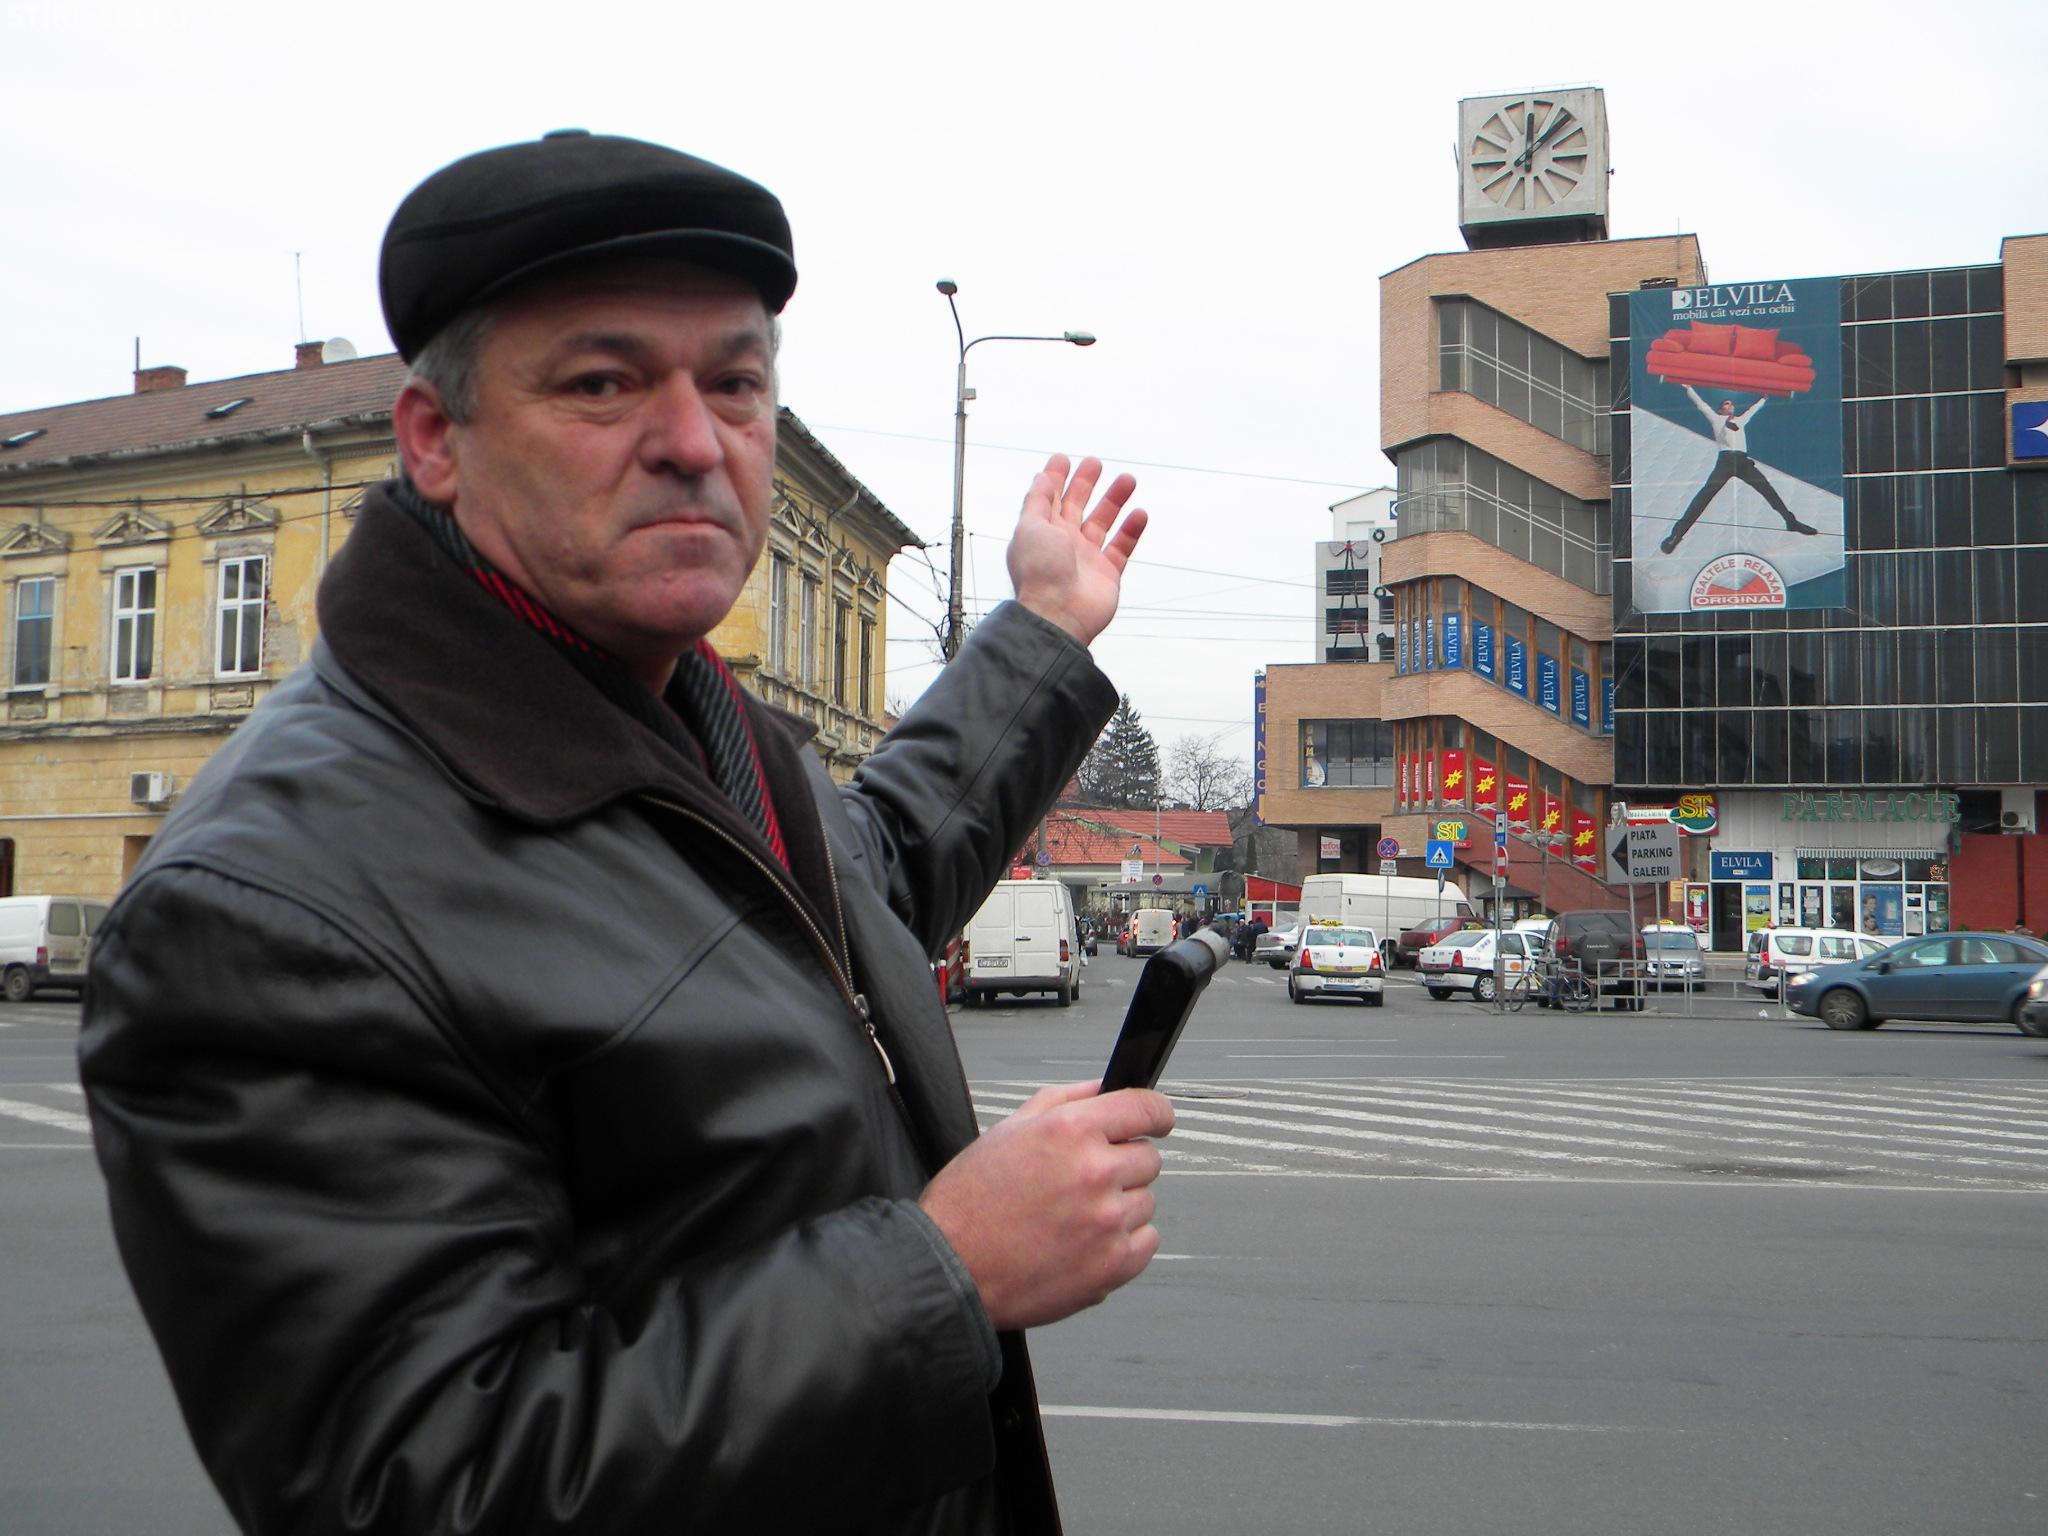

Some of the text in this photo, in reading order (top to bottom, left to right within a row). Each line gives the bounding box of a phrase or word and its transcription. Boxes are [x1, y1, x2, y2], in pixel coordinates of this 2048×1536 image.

[1729, 305, 1751, 317] vezi
[1753, 307, 1766, 315] cu
[1769, 303, 1795, 314] ochii
[1695, 558, 1735, 596] SALTELE
[1744, 558, 1780, 594] RELAXA
[1695, 595, 1782, 605] ORIGINAL
[1478, 625, 1488, 662] ELVILA
[1511, 641, 1521, 681] ELVILA
[1543, 659, 1554, 701] ELVILA
[1575, 673, 1585, 711] ELVILA
[1680, 795, 1712, 818] ST
[1780, 792, 1962, 823] FARMACIE
[1437, 821, 1463, 840] ST
[1630, 829, 1657, 842] PIATA
[1631, 847, 1673, 859] PARKING
[1721, 857, 1762, 868] ELVILA
[1632, 866, 1670, 877] GALERII
